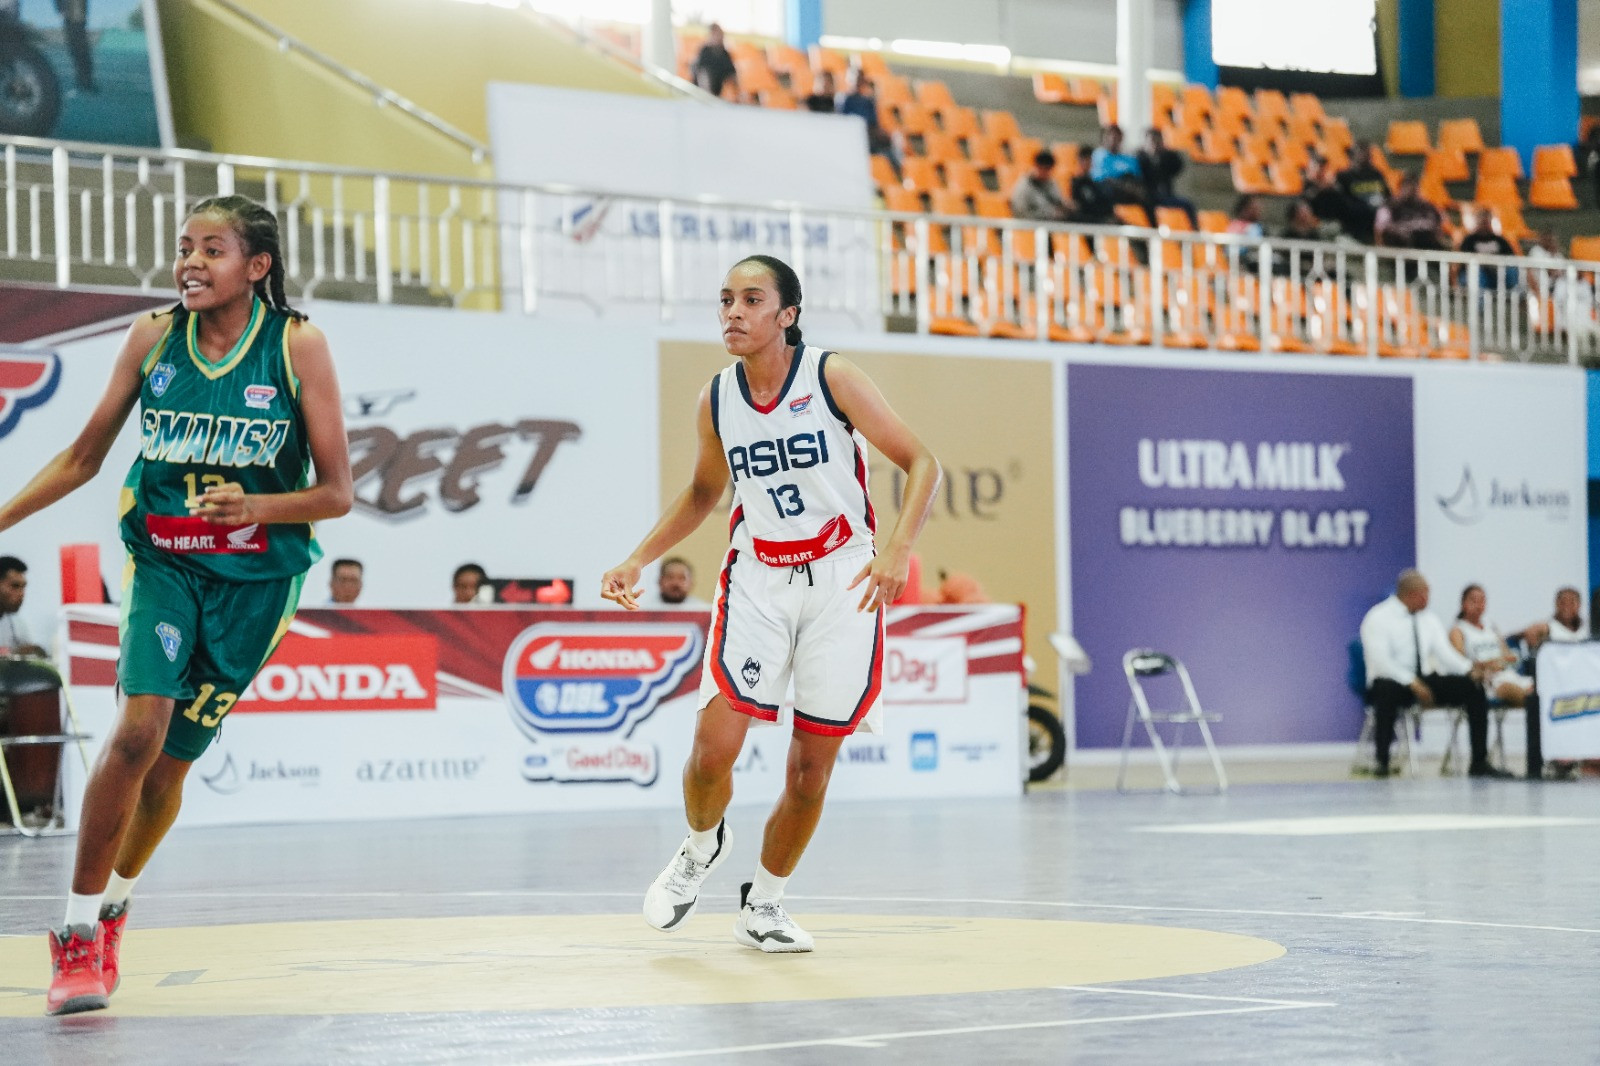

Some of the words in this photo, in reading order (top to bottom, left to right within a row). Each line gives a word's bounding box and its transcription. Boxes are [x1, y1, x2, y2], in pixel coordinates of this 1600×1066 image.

[140, 409, 290, 469] SMANSA
[727, 430, 829, 482] ASISI
[1138, 439, 1254, 489] ULTRA
[1255, 442, 1346, 491] MILK
[766, 483, 805, 519] 13
[151, 533, 172, 549] One
[1119, 507, 1274, 546] BLUEBERRY
[1281, 509, 1370, 547] BLAST
[759, 551, 778, 564] One
[558, 649, 656, 670] HONDA
[888, 649, 939, 691] Day
[183, 683, 237, 728] 13
[248, 760, 320, 781] Jackson
